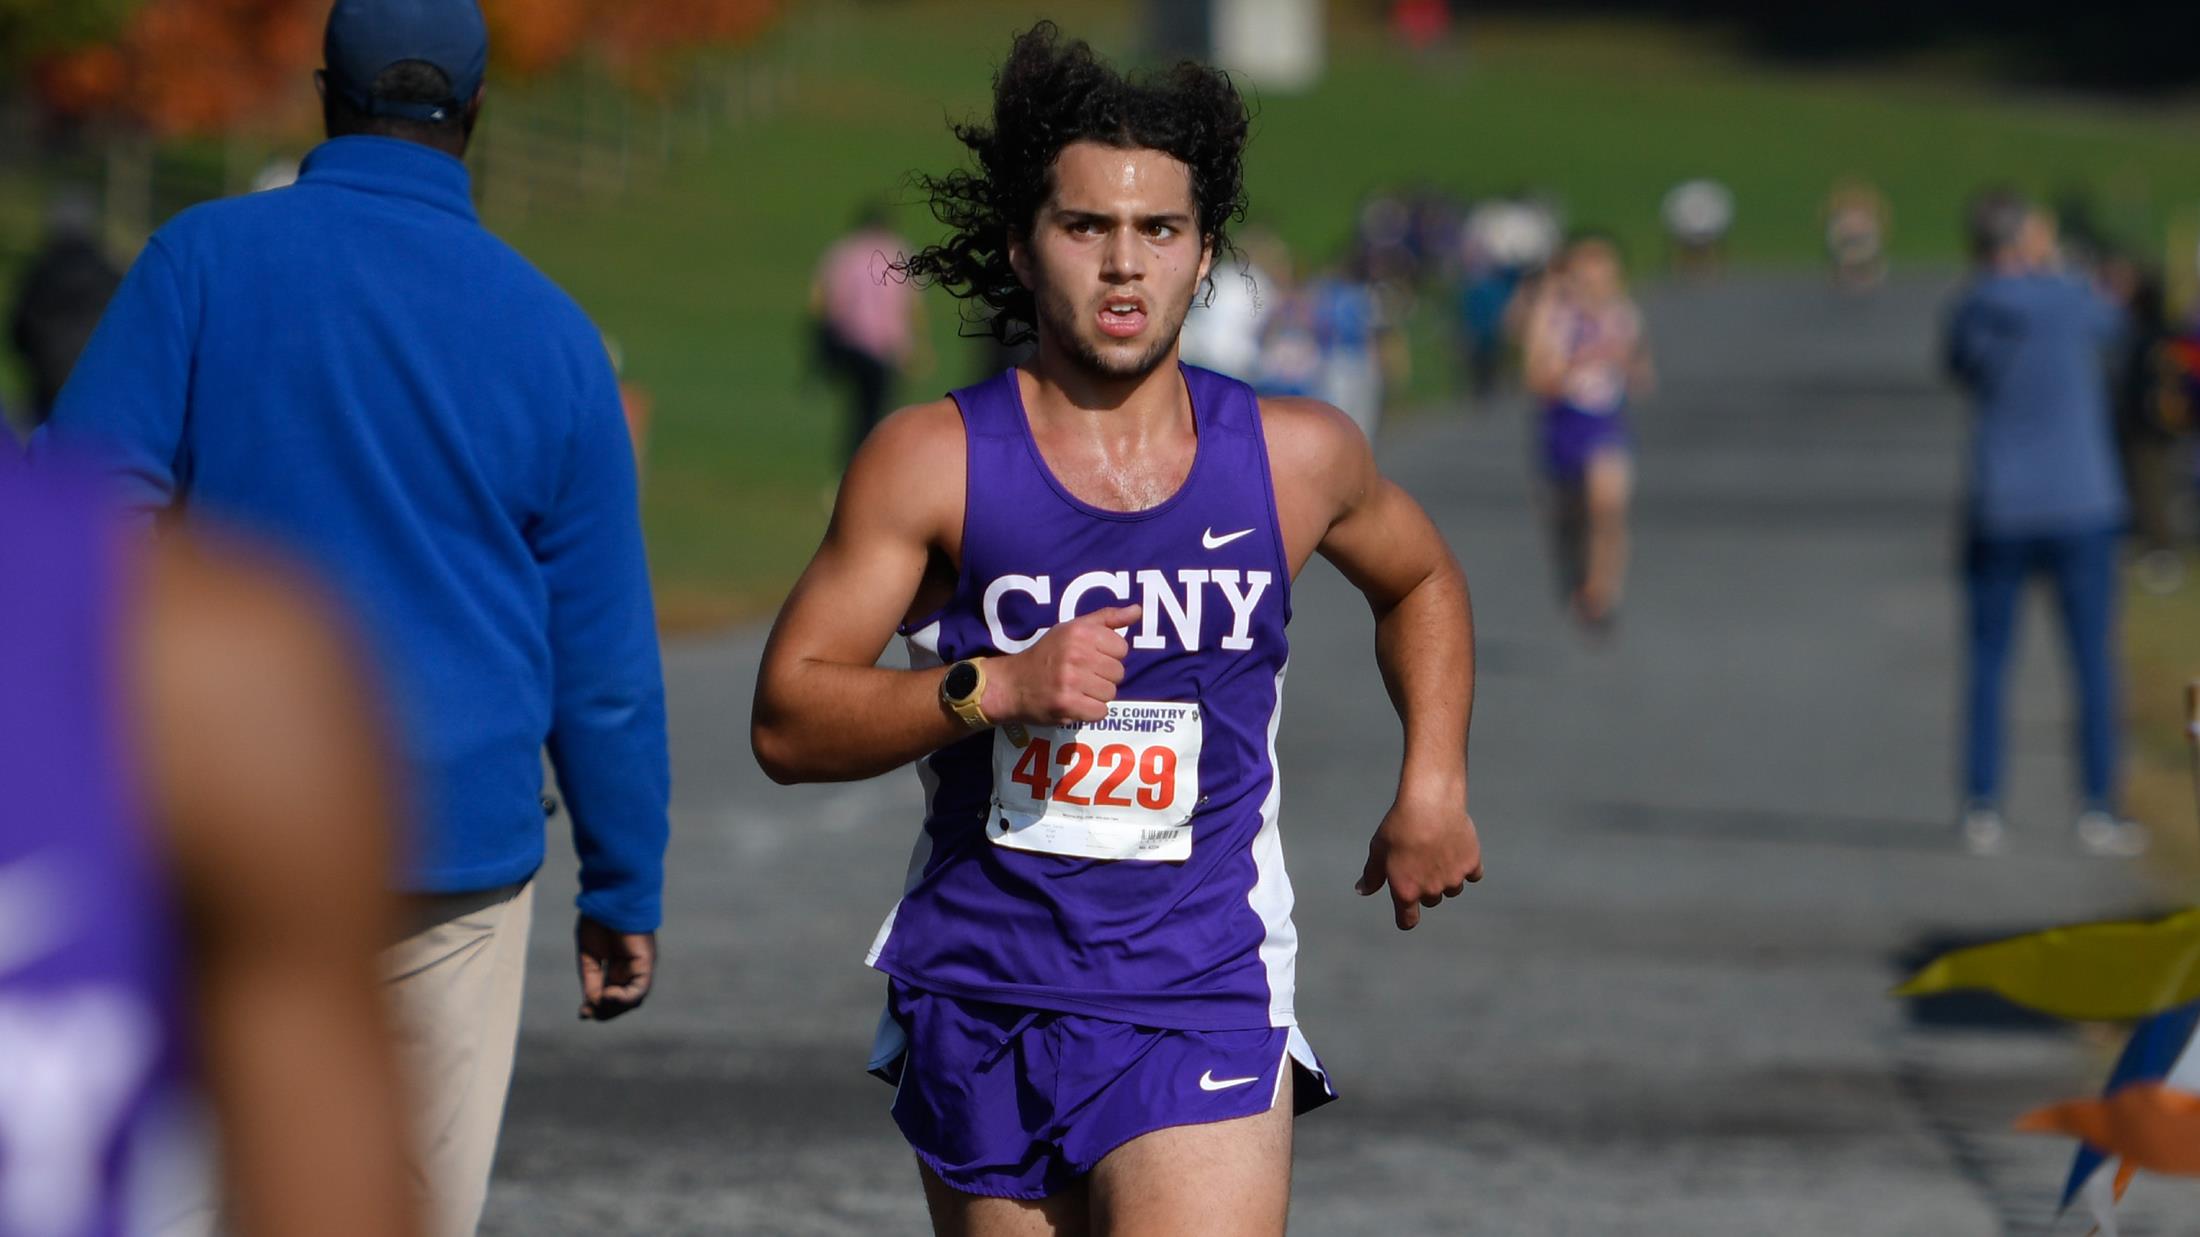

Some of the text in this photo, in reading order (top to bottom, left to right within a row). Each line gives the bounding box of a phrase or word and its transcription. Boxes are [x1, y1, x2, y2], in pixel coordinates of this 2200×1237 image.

[983, 569, 1272, 654] CCNY
[1122, 707, 1187, 720] COUNTRY
[1011, 737, 1177, 810] 4229
